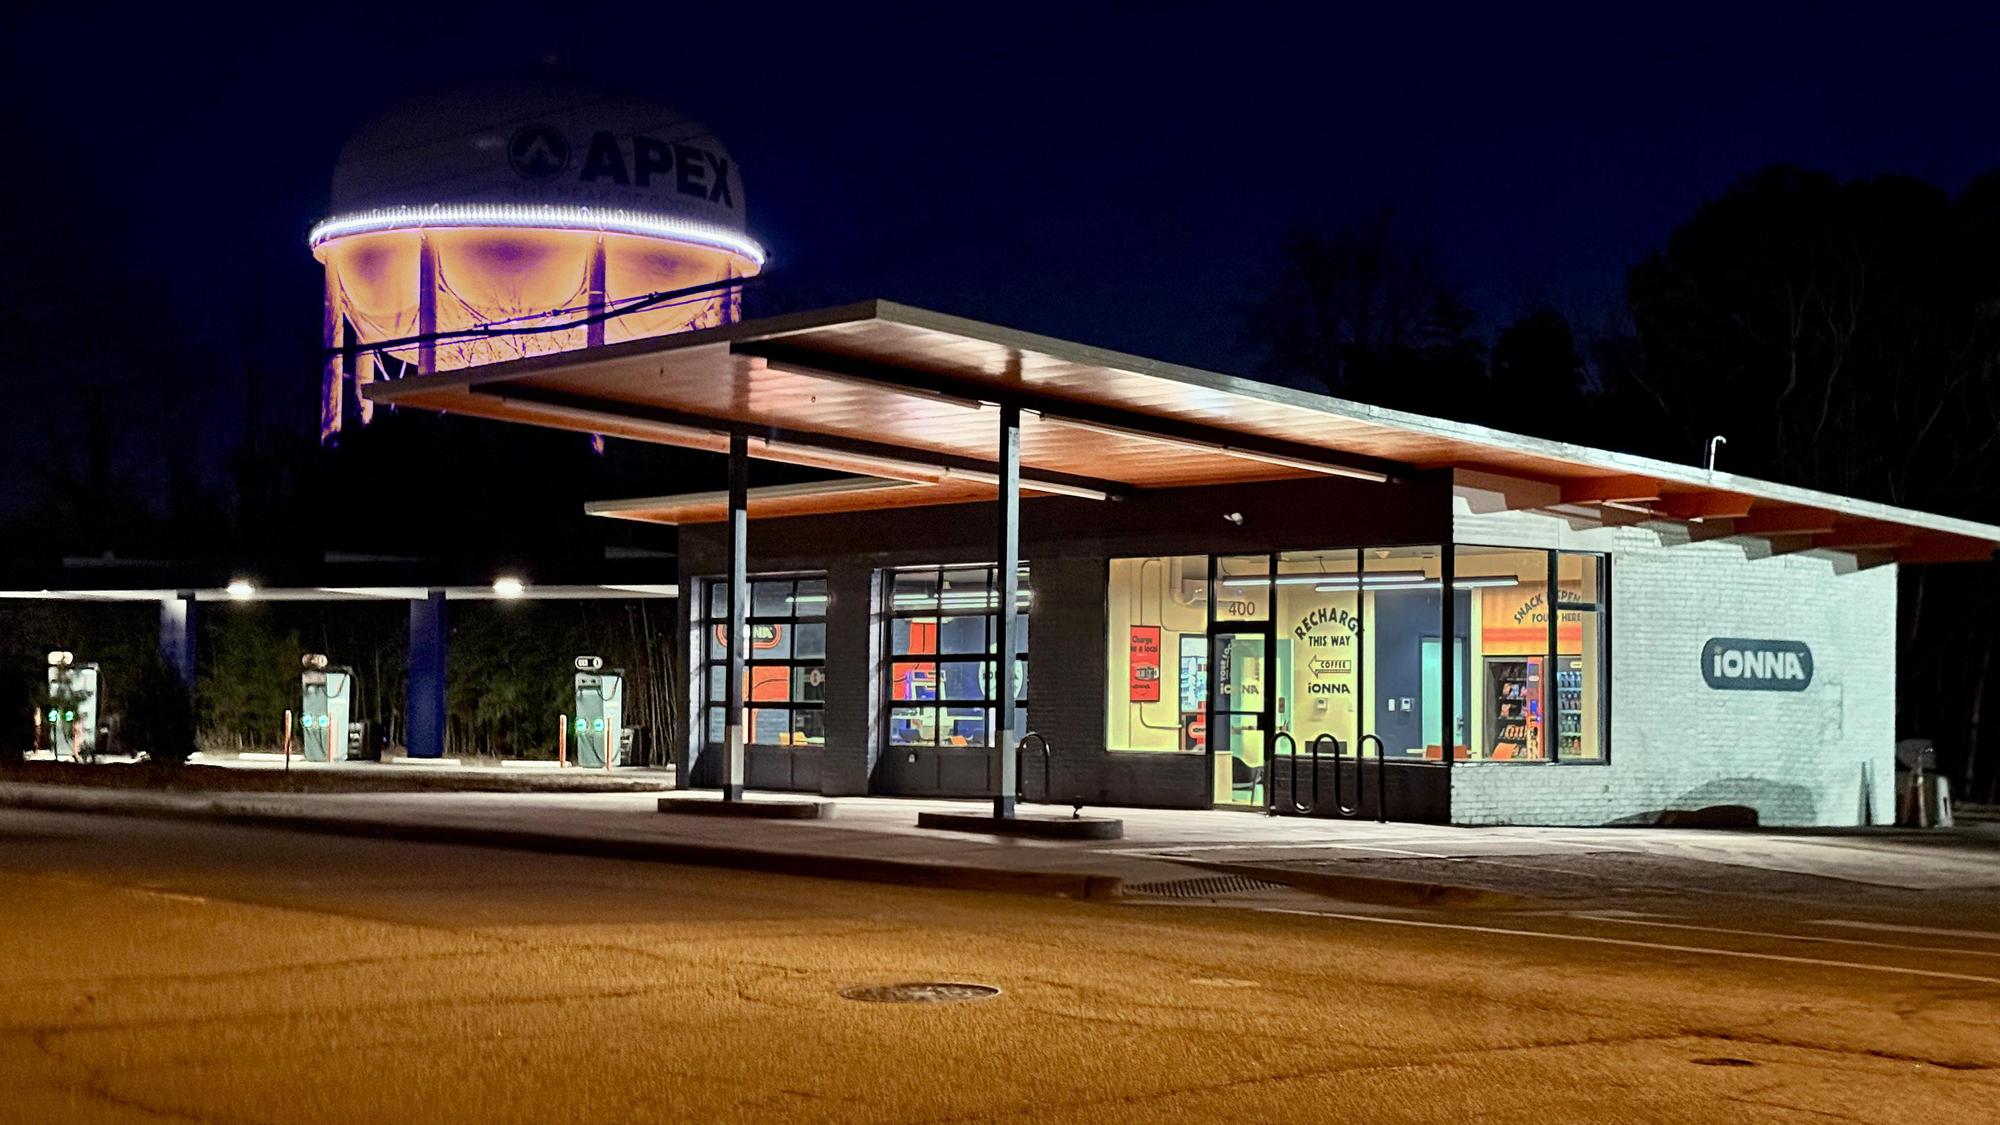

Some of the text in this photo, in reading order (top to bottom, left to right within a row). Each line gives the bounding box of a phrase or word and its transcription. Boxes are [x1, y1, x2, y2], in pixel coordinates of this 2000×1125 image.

[580, 131, 733, 209] APEX
[1228, 601, 1255, 616] 400
[1514, 593, 1543, 625] SNACK
[1294, 607, 1365, 640] RECHARG
[1561, 612, 1581, 622] HERE
[1308, 635, 1351, 647] THIS WAY
[1320, 660, 1347, 669] COFFEE
[1713, 646, 1805, 680] iONNA
[1307, 682, 1351, 694] iONNA
